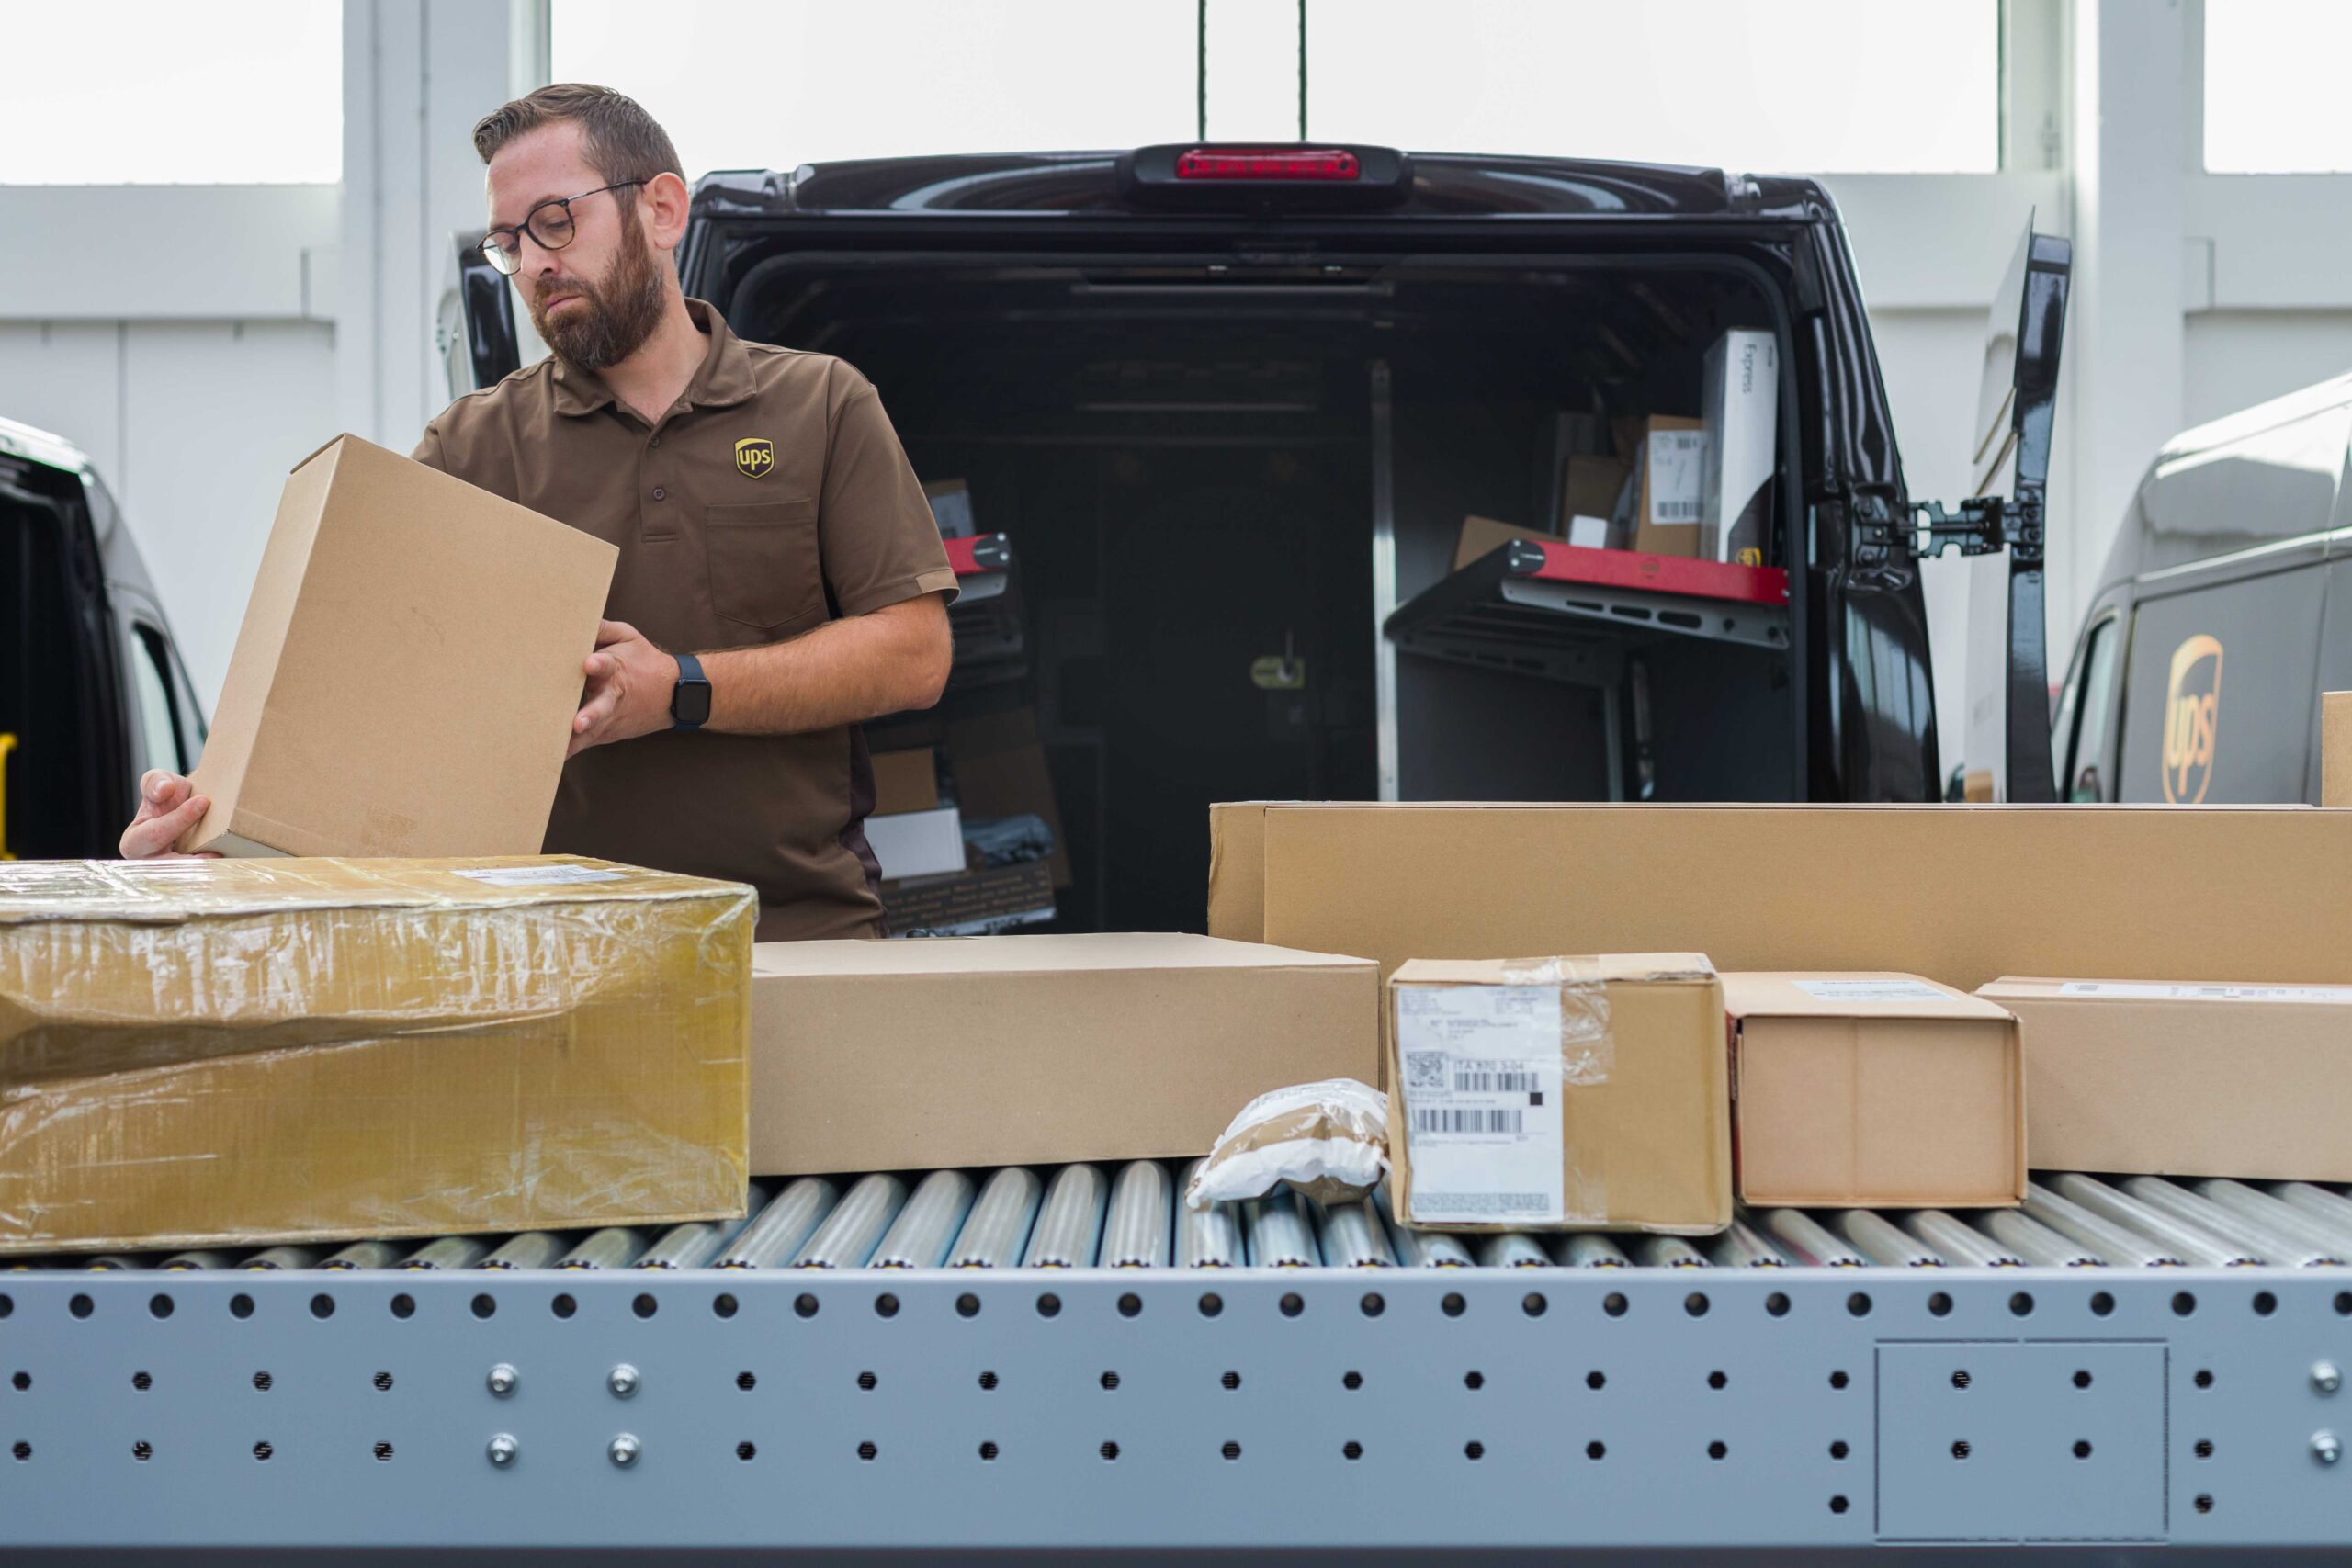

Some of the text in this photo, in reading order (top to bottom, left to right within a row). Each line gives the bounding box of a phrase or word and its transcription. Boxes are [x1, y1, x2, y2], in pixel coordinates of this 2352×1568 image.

[1739, 344, 1758, 394] Express
[739, 449, 771, 471] ups
[2167, 692, 2214, 797] ups
